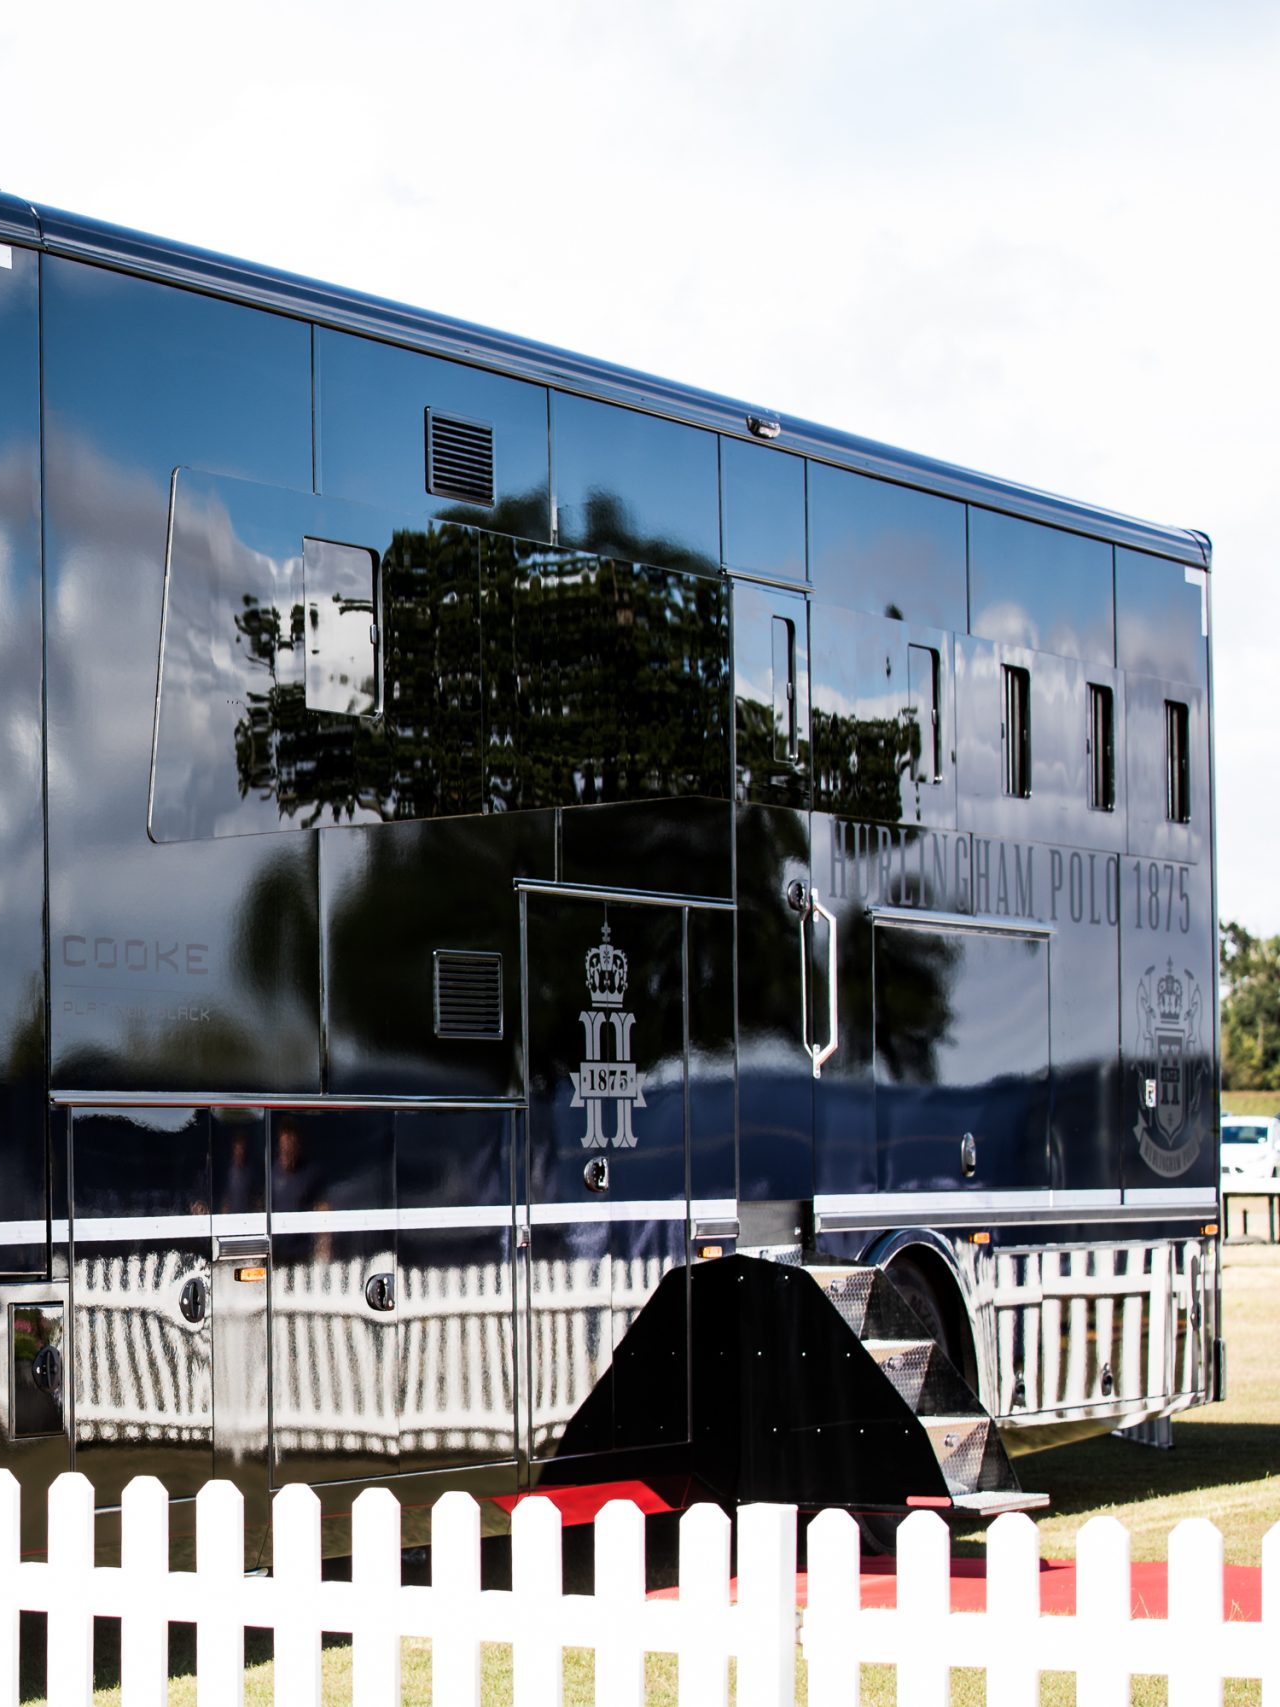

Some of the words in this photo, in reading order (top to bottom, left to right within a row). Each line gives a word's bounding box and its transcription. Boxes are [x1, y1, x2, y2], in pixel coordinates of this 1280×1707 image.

[828, 818, 1036, 918] HURLINGHAM
[1049, 849, 1119, 926] POLO
[1133, 860, 1190, 934] 1875
[63, 934, 209, 975] COOKE
[588, 1068, 628, 1091] 1875
